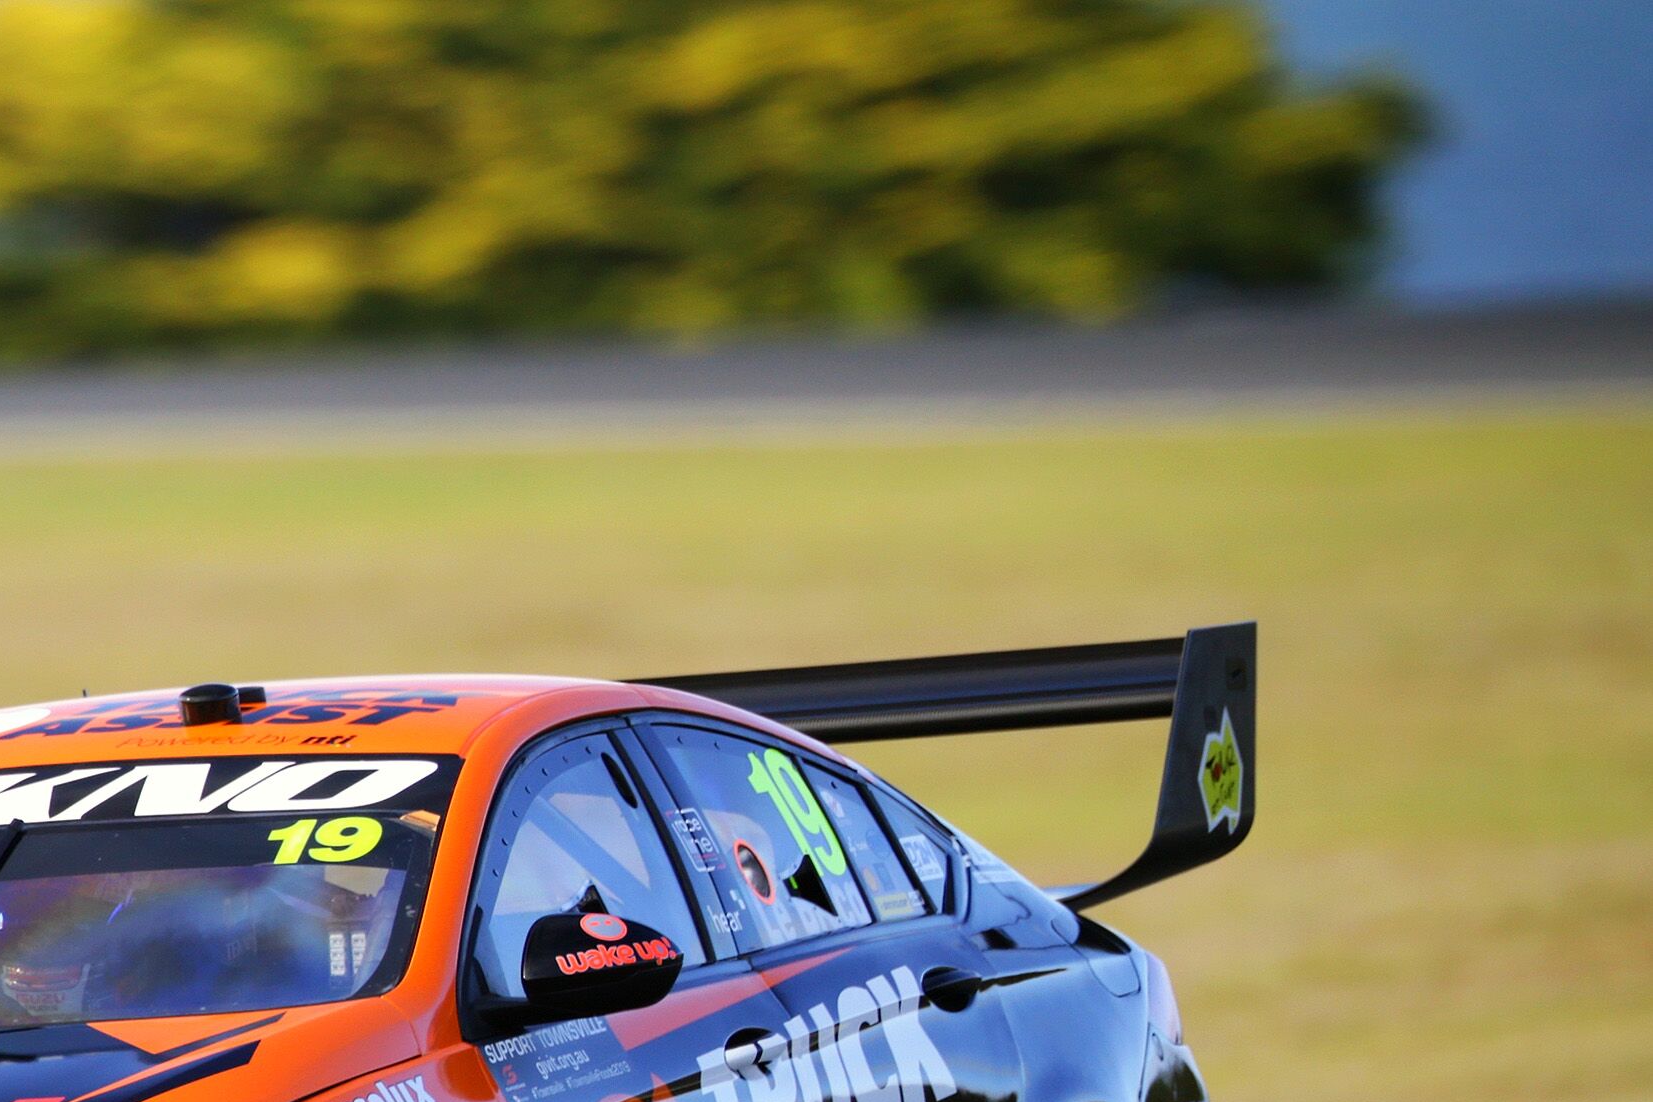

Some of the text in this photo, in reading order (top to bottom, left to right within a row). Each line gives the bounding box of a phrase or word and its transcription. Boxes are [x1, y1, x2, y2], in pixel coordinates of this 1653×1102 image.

[116, 733, 246, 750] Powered
[250, 733, 294, 747] by
[748, 748, 846, 876] 19
[266, 816, 383, 866] 19
[706, 905, 744, 935] hear
[555, 936, 678, 975] wake up!
[484, 1016, 608, 1064] SUPPORT TOWNSVILLE
[535, 1048, 590, 1081] givit.org.au
